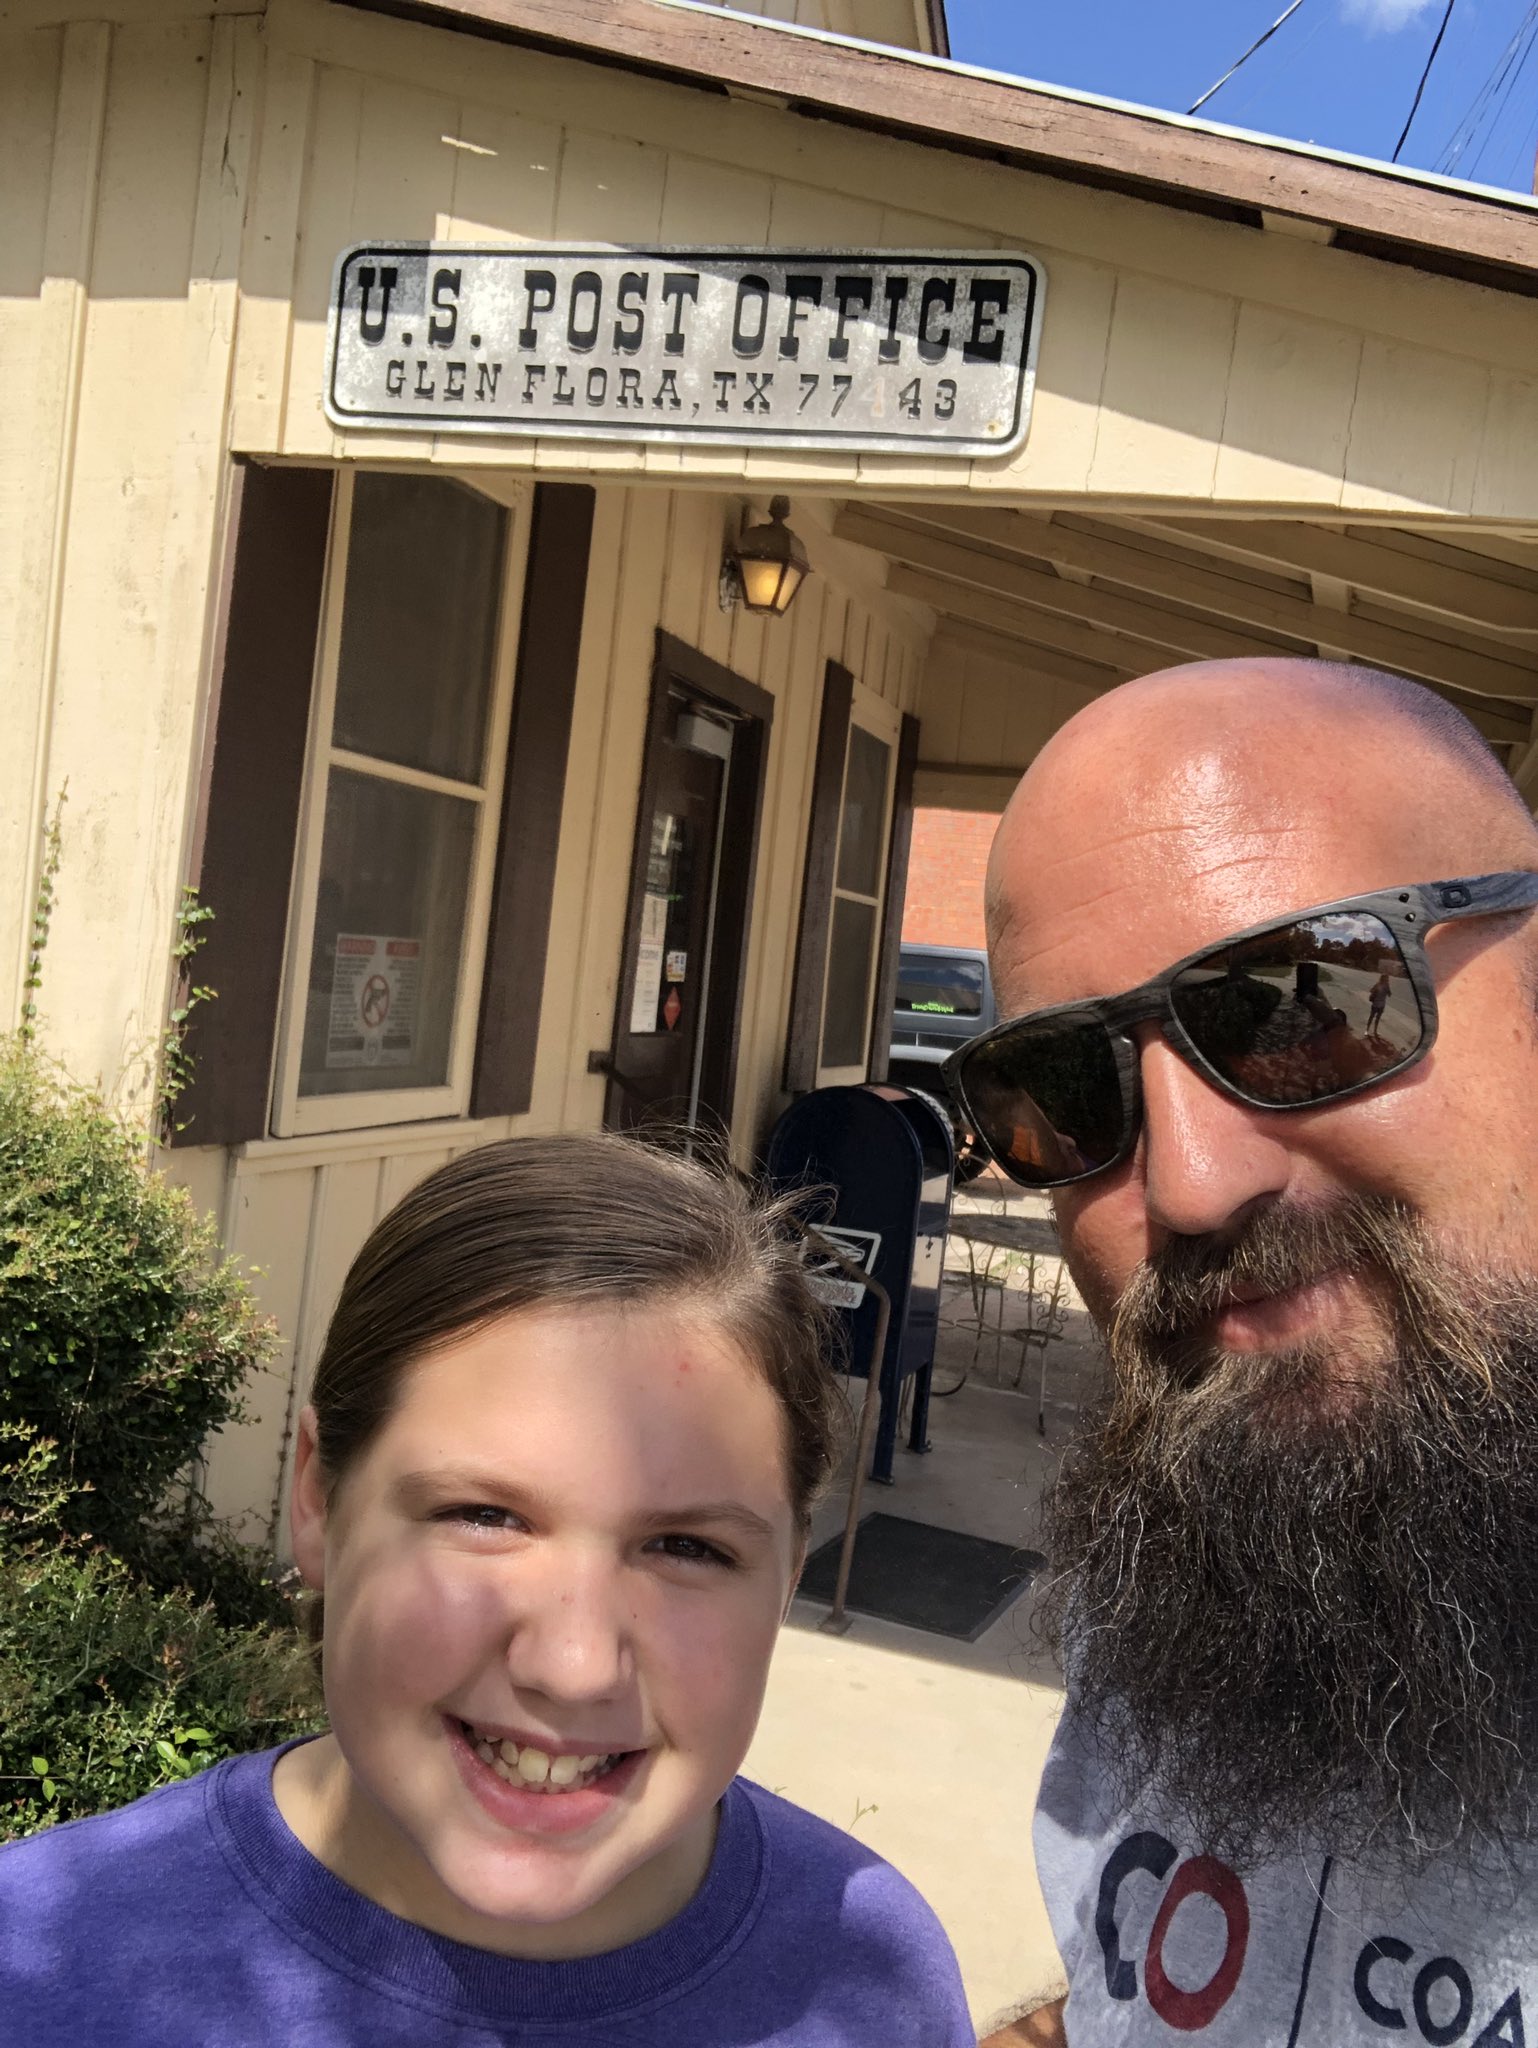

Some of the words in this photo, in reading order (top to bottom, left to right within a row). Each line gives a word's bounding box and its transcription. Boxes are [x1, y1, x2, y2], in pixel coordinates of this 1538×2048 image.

[357, 266, 482, 349] U.S.
[518, 269, 700, 357] POST
[731, 273, 1011, 366] OFFICE
[386, 359, 502, 402] GLEN
[712, 370, 774, 414] TX
